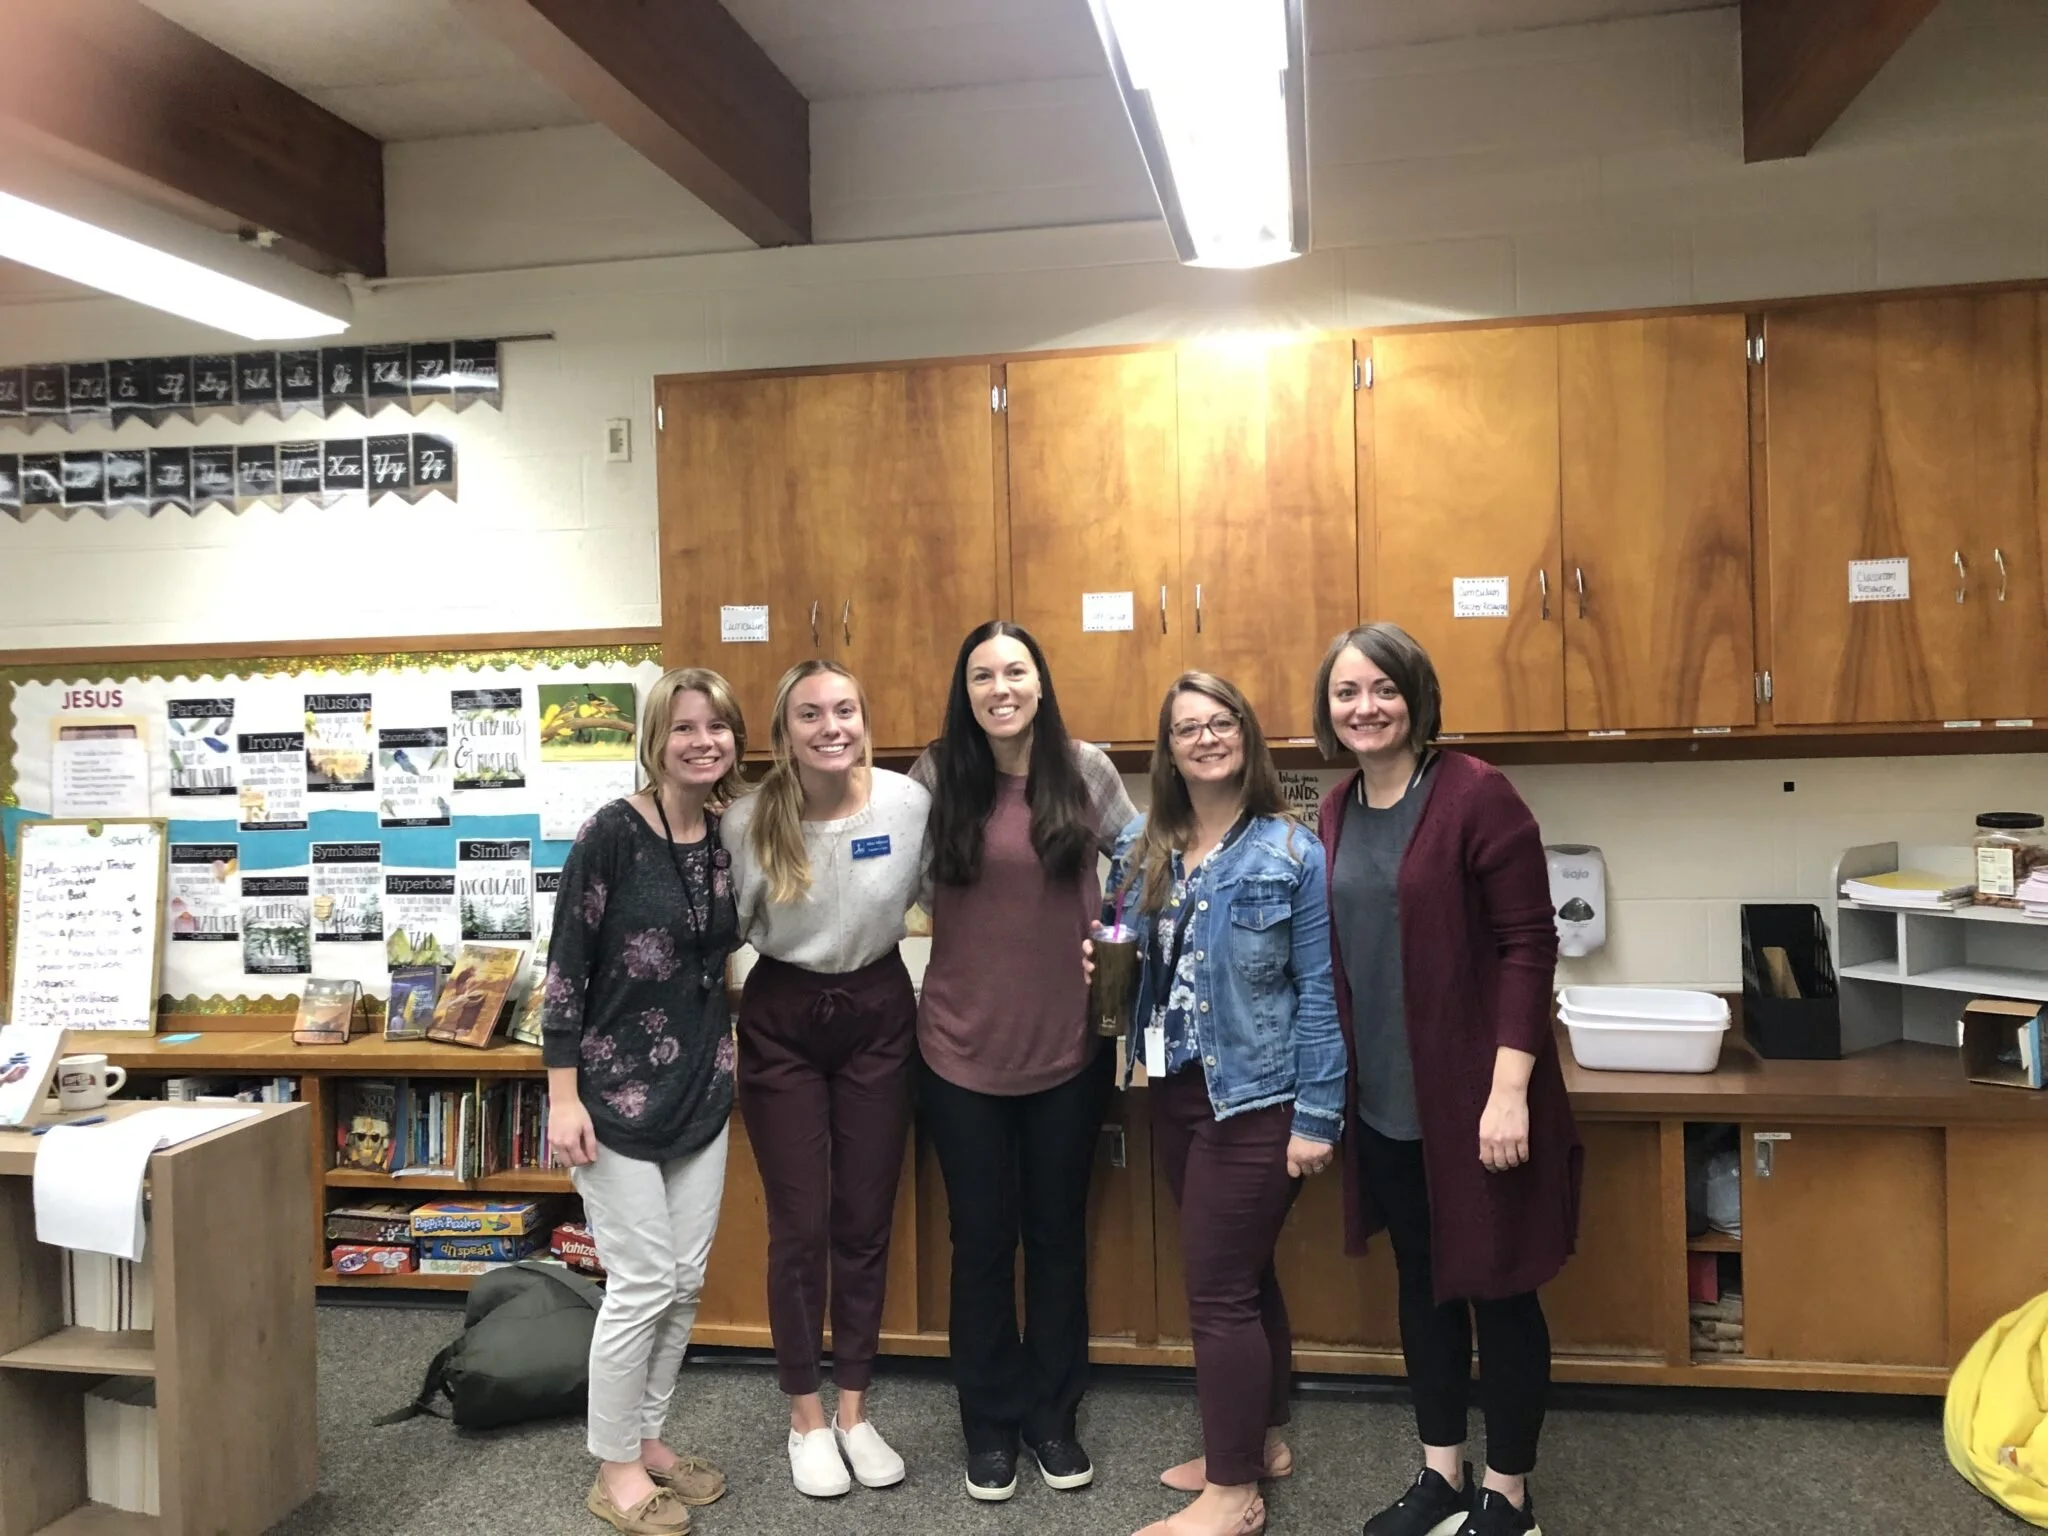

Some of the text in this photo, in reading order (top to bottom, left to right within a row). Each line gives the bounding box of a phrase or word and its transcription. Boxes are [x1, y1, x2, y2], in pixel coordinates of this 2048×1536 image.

[328, 456, 361, 476] Xx
[372, 453, 407, 484] Yy
[62, 690, 123, 709] JESUS
[306, 696, 370, 710] Allusion
[168, 701, 233, 718] Paradox
[248, 735, 294, 752] Irony
[313, 845, 380, 859] Symbolism
[470, 843, 520, 859] Simile
[388, 877, 453, 892] Hyperbole
[441, 1241, 494, 1258] Heads Up
[561, 1241, 597, 1257] Yahtze
